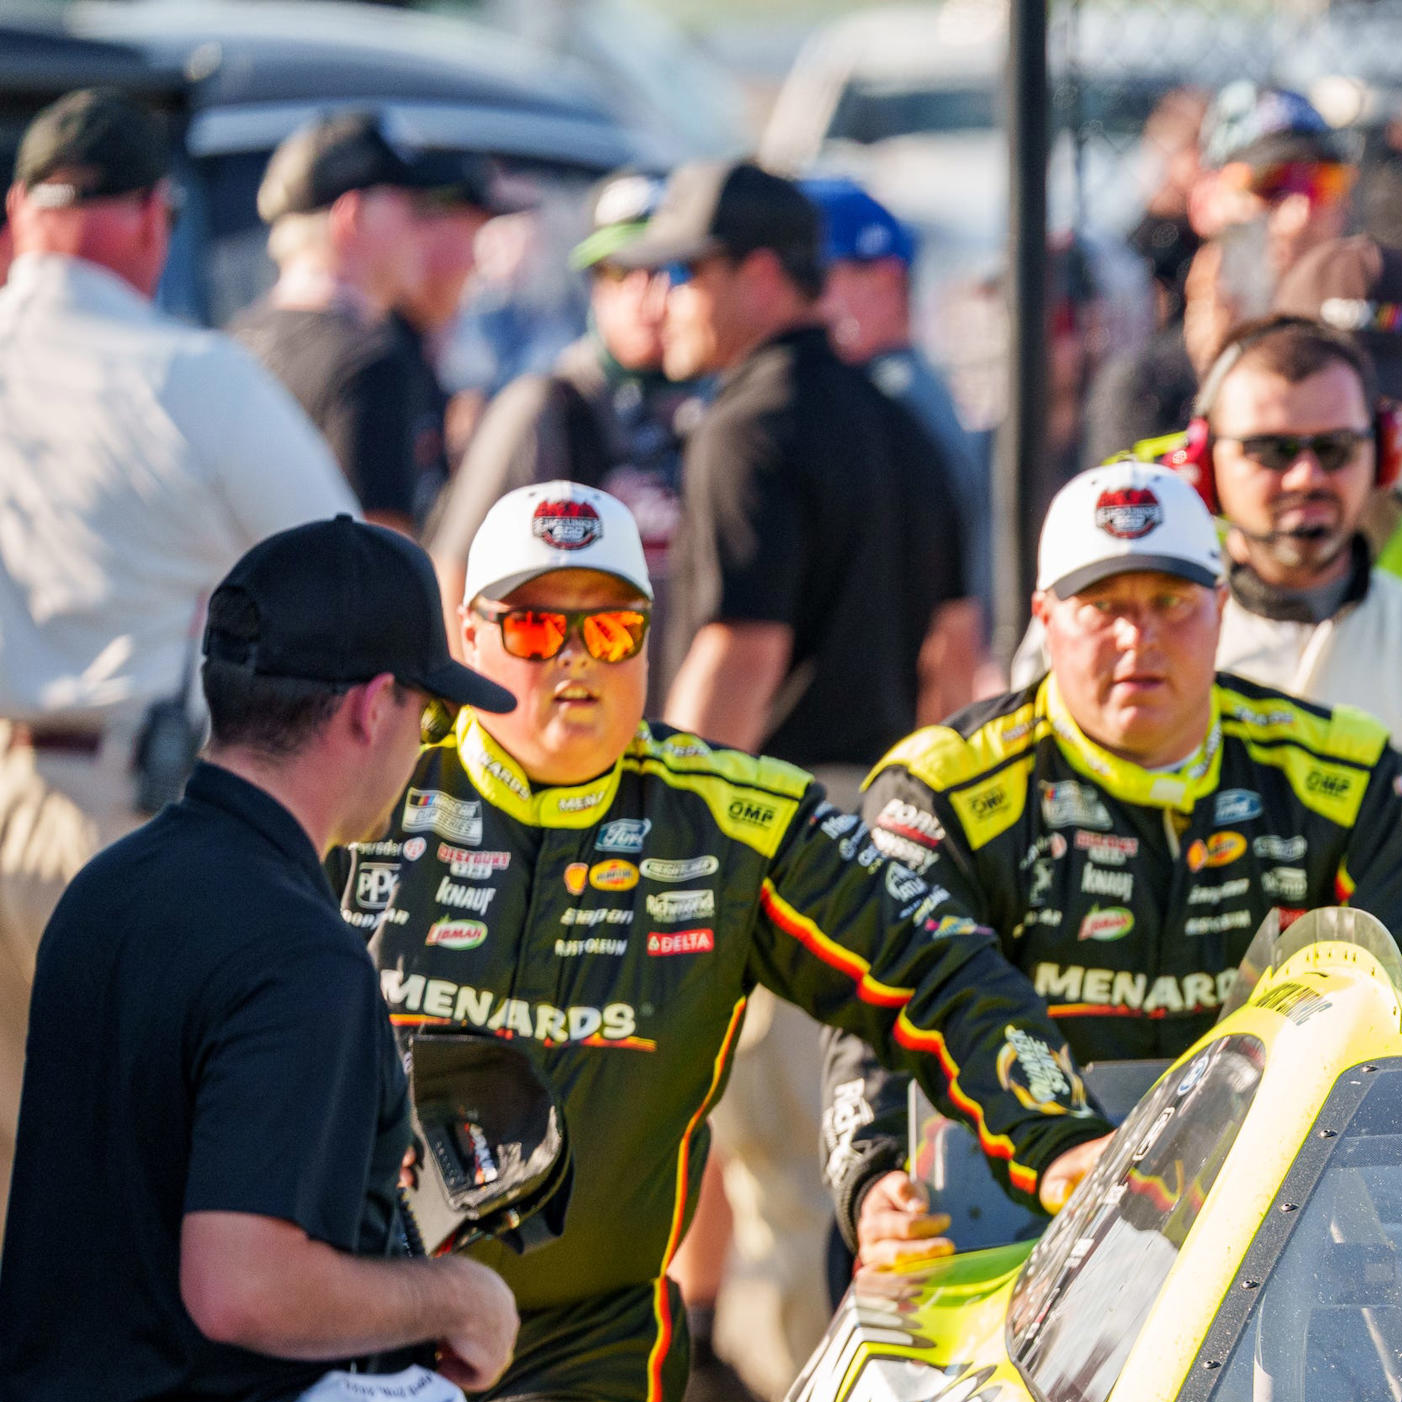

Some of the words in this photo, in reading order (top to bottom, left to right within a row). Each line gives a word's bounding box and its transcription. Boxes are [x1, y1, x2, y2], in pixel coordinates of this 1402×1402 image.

[729, 801, 774, 824] OMP
[435, 876, 496, 916] KNAUF
[661, 931, 711, 953] DELTA
[380, 969, 637, 1043] MENARDS
[1034, 962, 1238, 1012] MENARD
